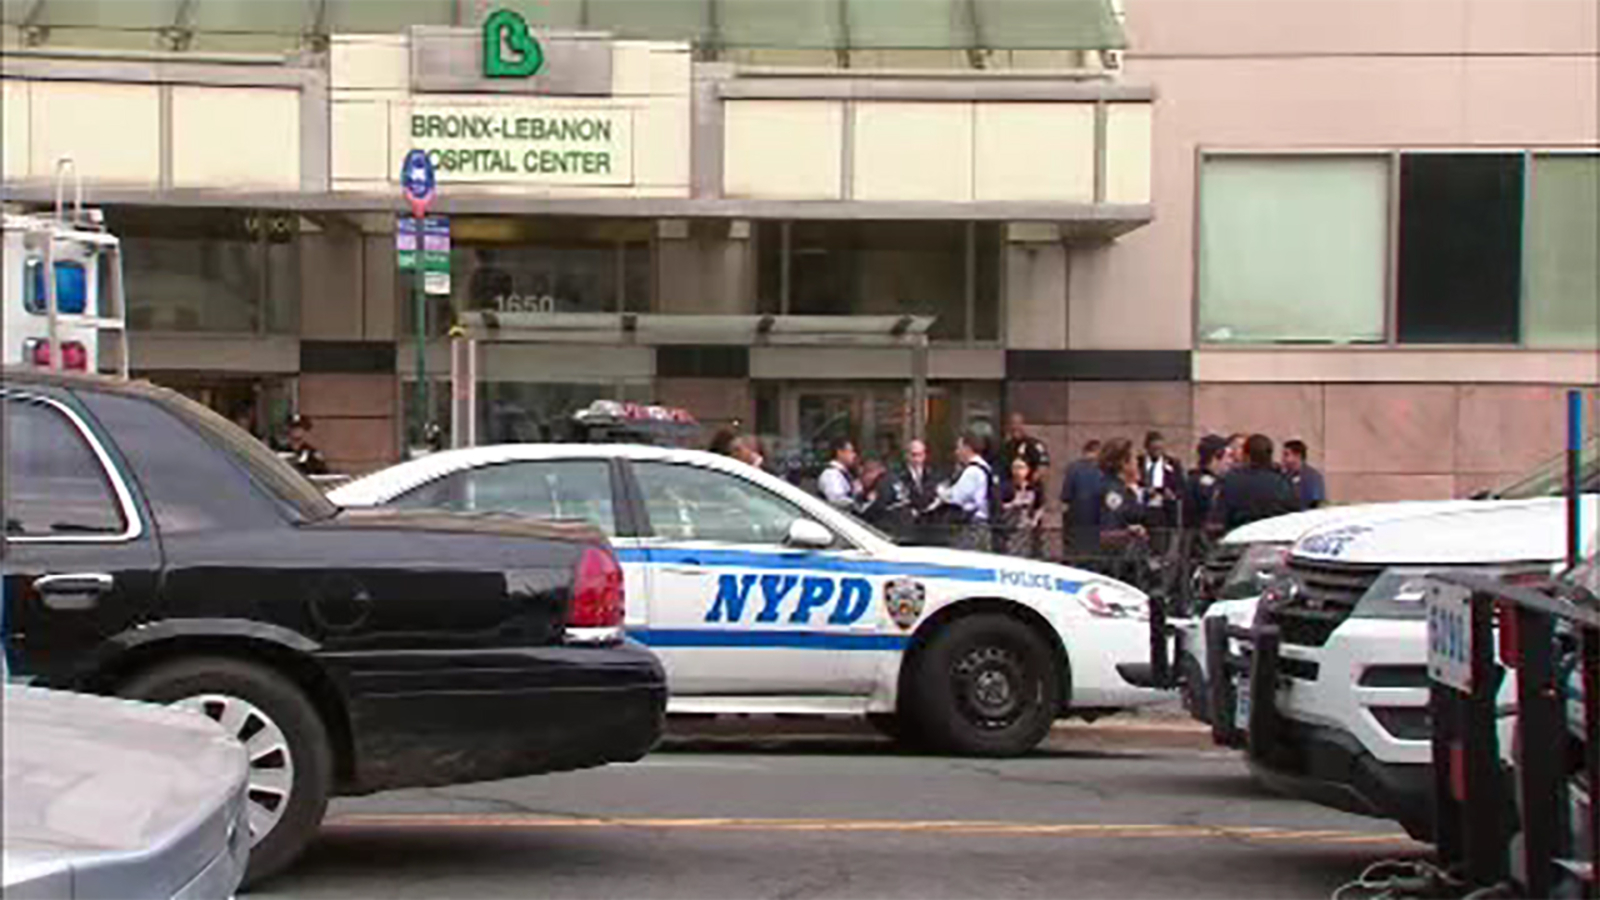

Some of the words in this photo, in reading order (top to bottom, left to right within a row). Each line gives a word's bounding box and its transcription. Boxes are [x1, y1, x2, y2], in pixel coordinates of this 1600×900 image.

[411, 114, 611, 141] BRONX-LEBANON
[427, 148, 516, 173] OSPITAL
[523, 150, 610, 173] CENTER
[494, 293, 554, 312] 1650
[1000, 568, 1053, 591] POLICE
[704, 574, 872, 625] NYPD
